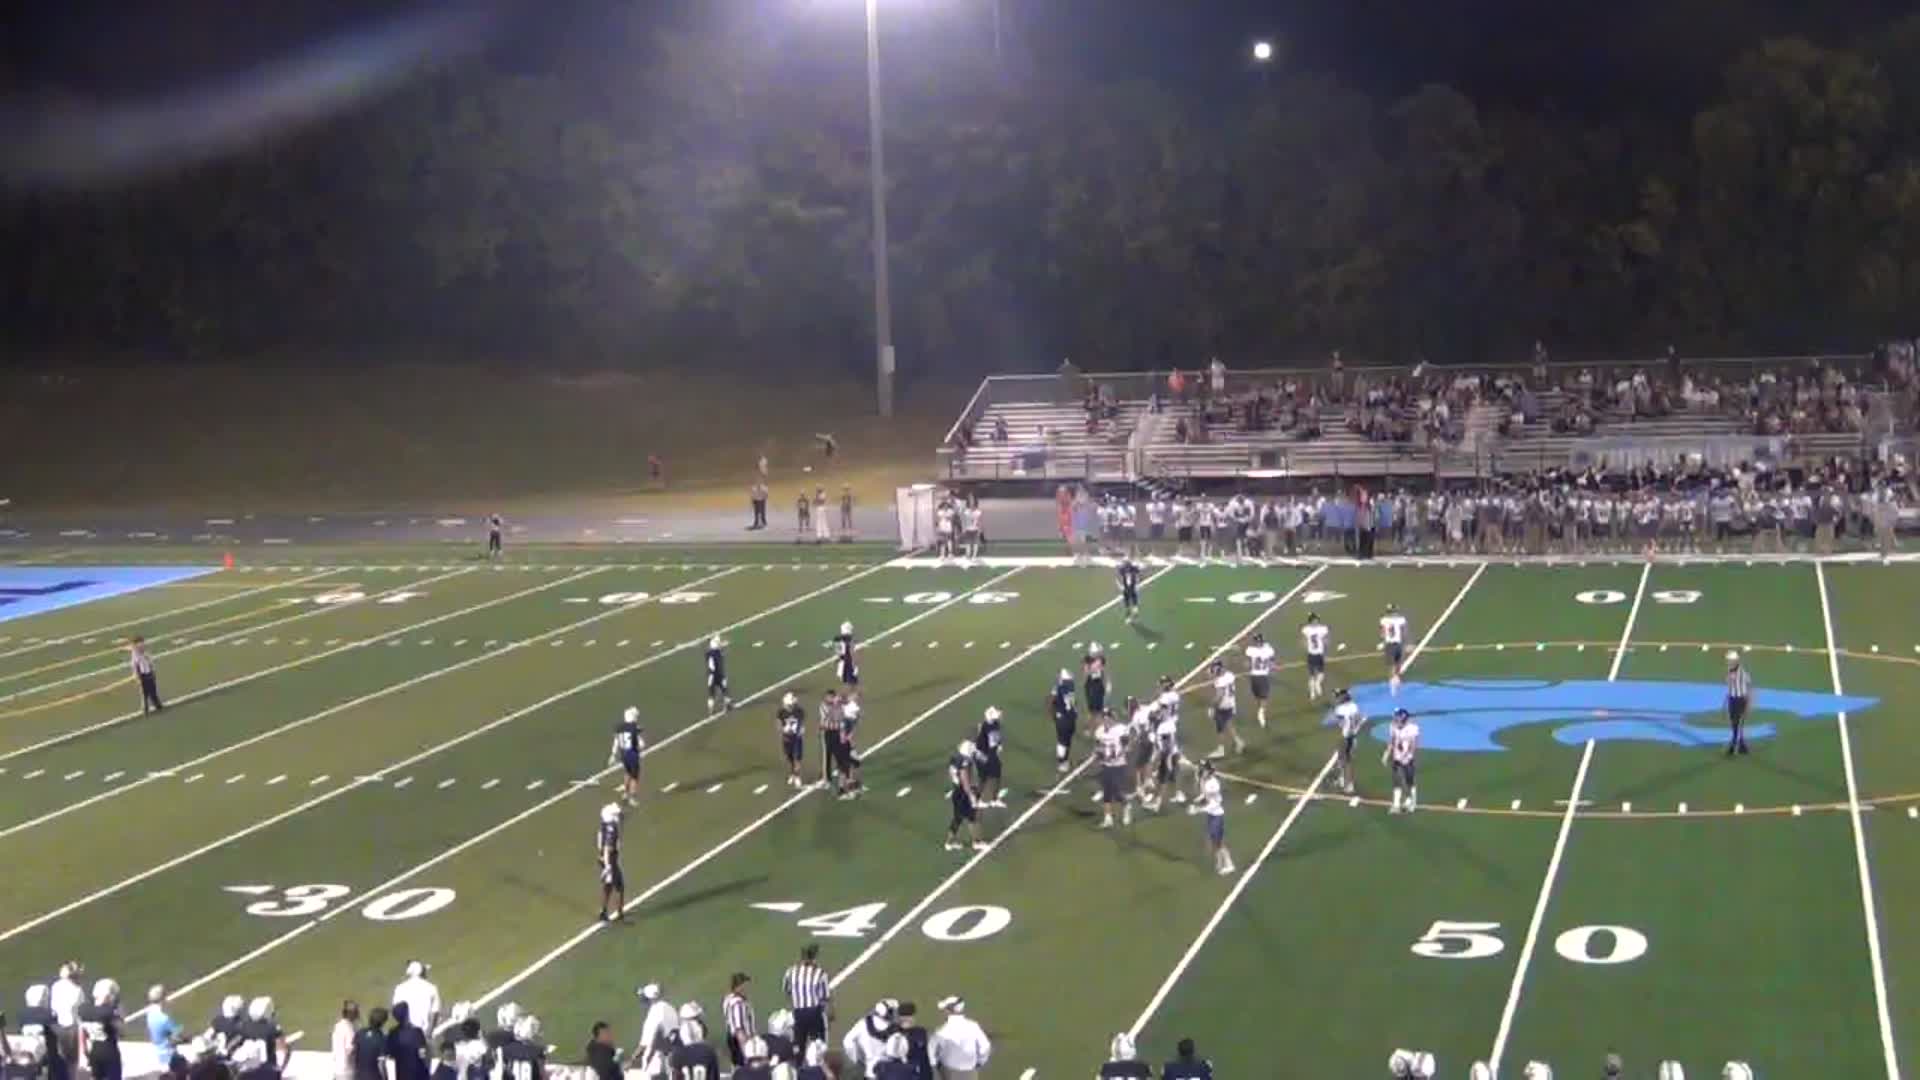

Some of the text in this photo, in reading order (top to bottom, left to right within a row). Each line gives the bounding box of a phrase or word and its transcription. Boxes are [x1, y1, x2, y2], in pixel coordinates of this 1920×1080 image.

[246, 884, 456, 920] 30
[797, 902, 1011, 940] 40
[1411, 920, 1648, 963] 50
